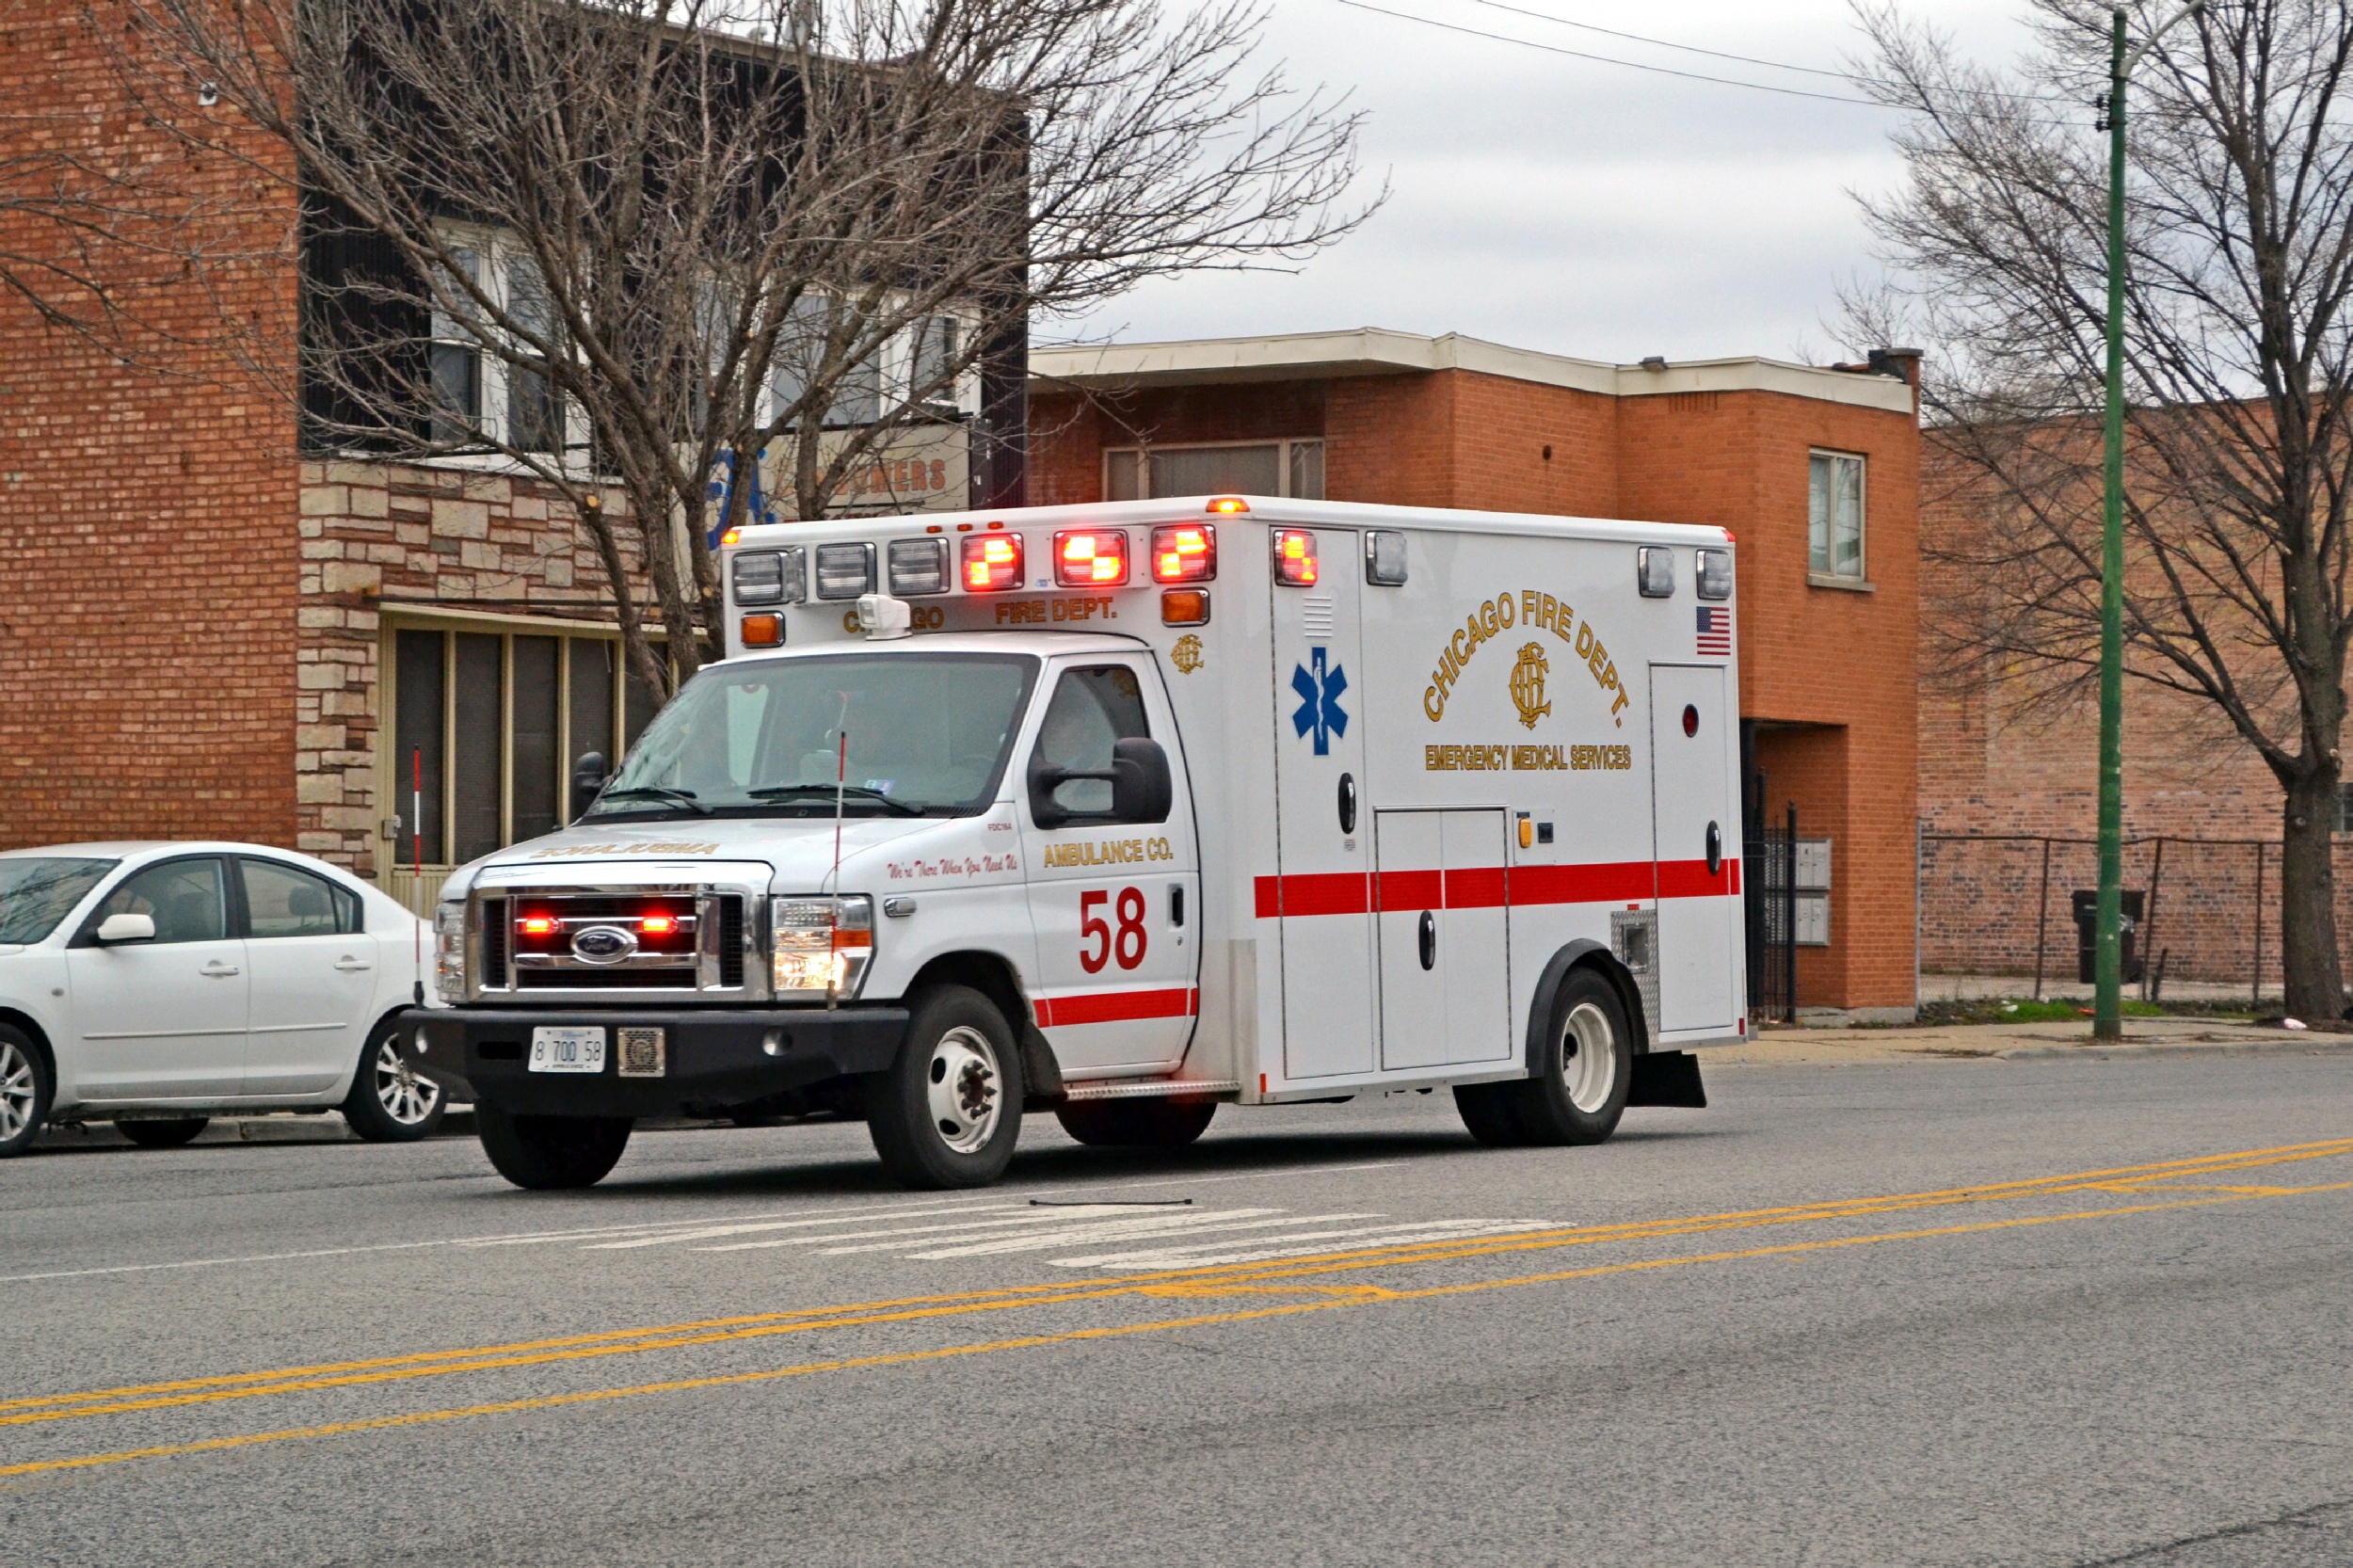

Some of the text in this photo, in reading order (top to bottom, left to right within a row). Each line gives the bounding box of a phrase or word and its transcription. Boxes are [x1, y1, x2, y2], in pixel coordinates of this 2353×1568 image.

[995, 596, 1118, 625] FIRE DEPT.
[1423, 589, 1630, 728] CHICAGO FIRE DEPT.
[1425, 744, 1632, 771] EMERGENCY MEDICAL SERVICES
[939, 857, 963, 875] When
[965, 856, 982, 879] You
[983, 855, 1003, 873] Need
[1044, 837, 1174, 868] AMBULANCE CO.
[1080, 886, 1147, 974] 58
[535, 1040, 545, 1061] 8
[553, 1040, 577, 1062] 700
[584, 1040, 602, 1062] 58
